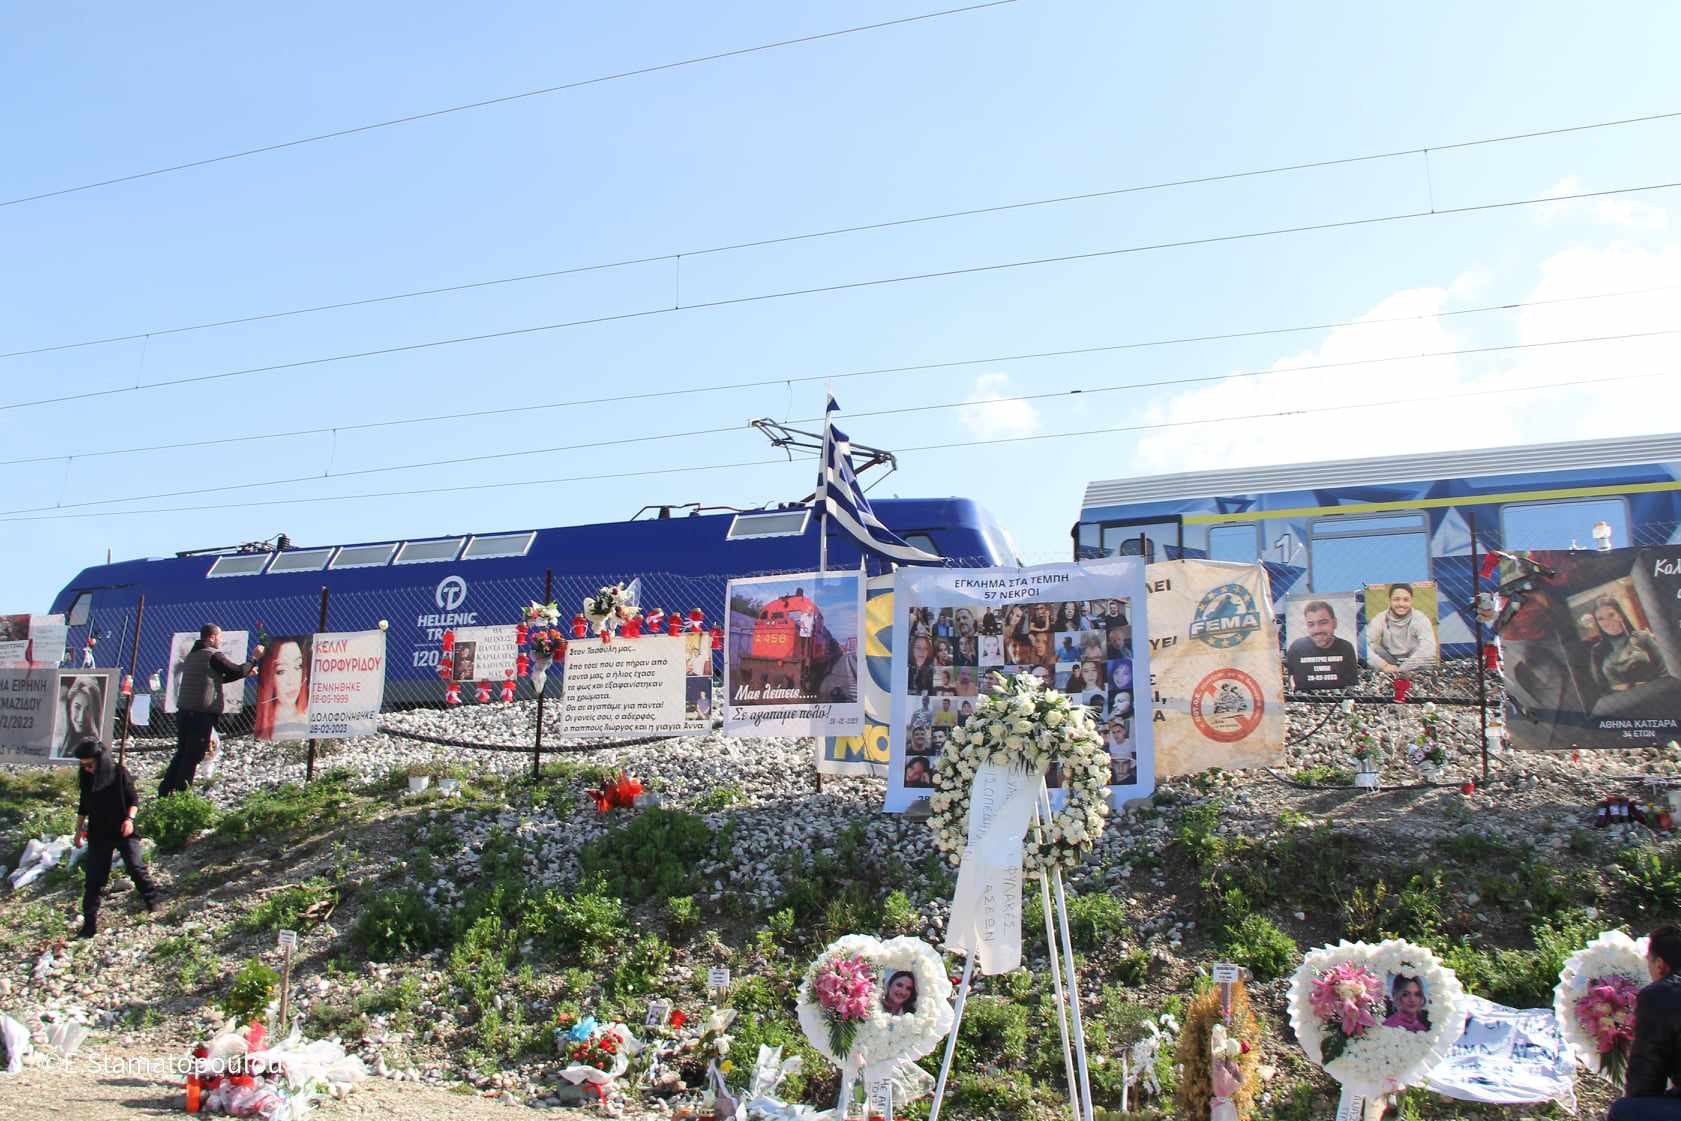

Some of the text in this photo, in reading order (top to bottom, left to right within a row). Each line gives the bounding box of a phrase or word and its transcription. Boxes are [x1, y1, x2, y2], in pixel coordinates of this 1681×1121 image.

[954, 574, 1069, 589] ΕΓΚΛΗΜΑ ΣΤΑ ΤΕΜΠΗ
[984, 588, 1040, 600] 57 ΝΕΚΡΟΙ
[417, 613, 477, 627] HELLENIC
[1191, 615, 1259, 635] FEMA
[316, 640, 348, 653] ΚΕΛΛΥ
[314, 658, 381, 672] ΠΟΡΦΥΡΙΔΟΥ
[413, 650, 440, 668] 120
[12, 680, 48, 692] ΕΙΡΗΝΗ
[732, 708, 747, 721] Σε
[1599, 719, 1677, 729] ΑΘΗΝΑ ΚΑΤΣΑΡΑ
